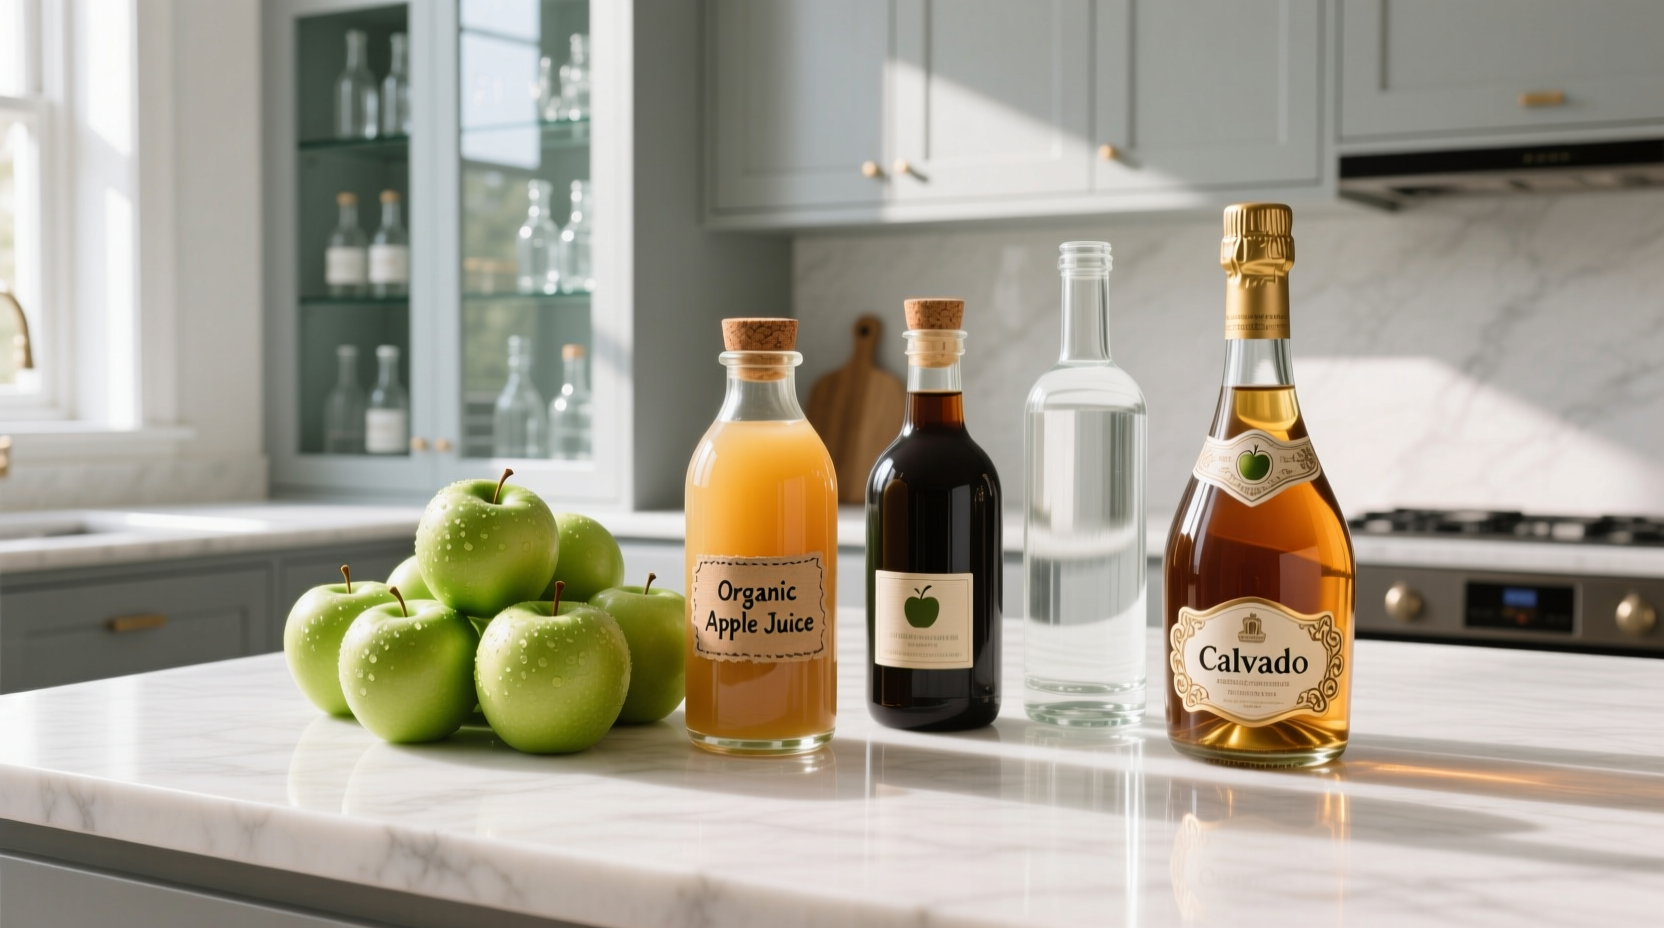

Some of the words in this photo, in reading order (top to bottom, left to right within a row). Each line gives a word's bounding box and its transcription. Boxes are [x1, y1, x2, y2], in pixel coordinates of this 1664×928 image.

[717, 580, 797, 610] Organic
[705, 610, 758, 641] Apple
[764, 612, 814, 634] Juice
[1199, 645, 1308, 674] Calvado
